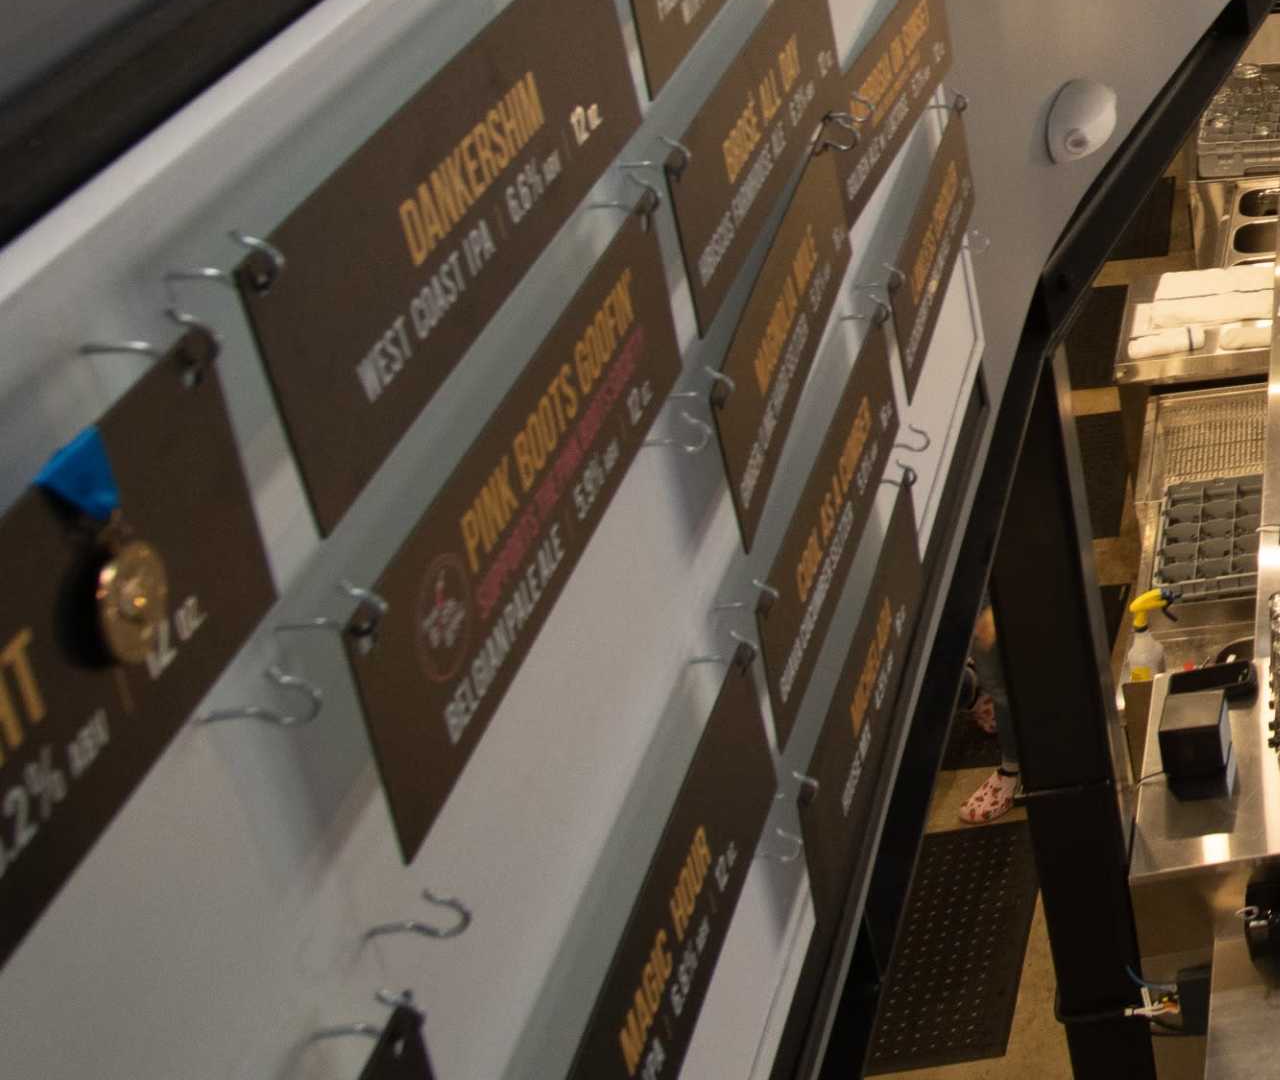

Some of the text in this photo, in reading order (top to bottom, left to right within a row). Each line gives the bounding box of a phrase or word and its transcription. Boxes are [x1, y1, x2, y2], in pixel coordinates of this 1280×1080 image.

[355, 315, 413, 403] WEST
[408, 251, 467, 339] COAST
[462, 220, 496, 277] IPA
[505, 156, 544, 223] 6.6%
[570, 104, 591, 146] 12
[399, 71, 544, 266] DANKERSHIM
[444, 614, 511, 745] BELGIAN
[503, 561, 542, 643] PALE
[537, 522, 565, 587] ALE
[627, 386, 643, 425] 12
[462, 455, 519, 572] PINK
[513, 363, 579, 493] BOOTS
[620, 825, 712, 1077] MAGIC HOUR
